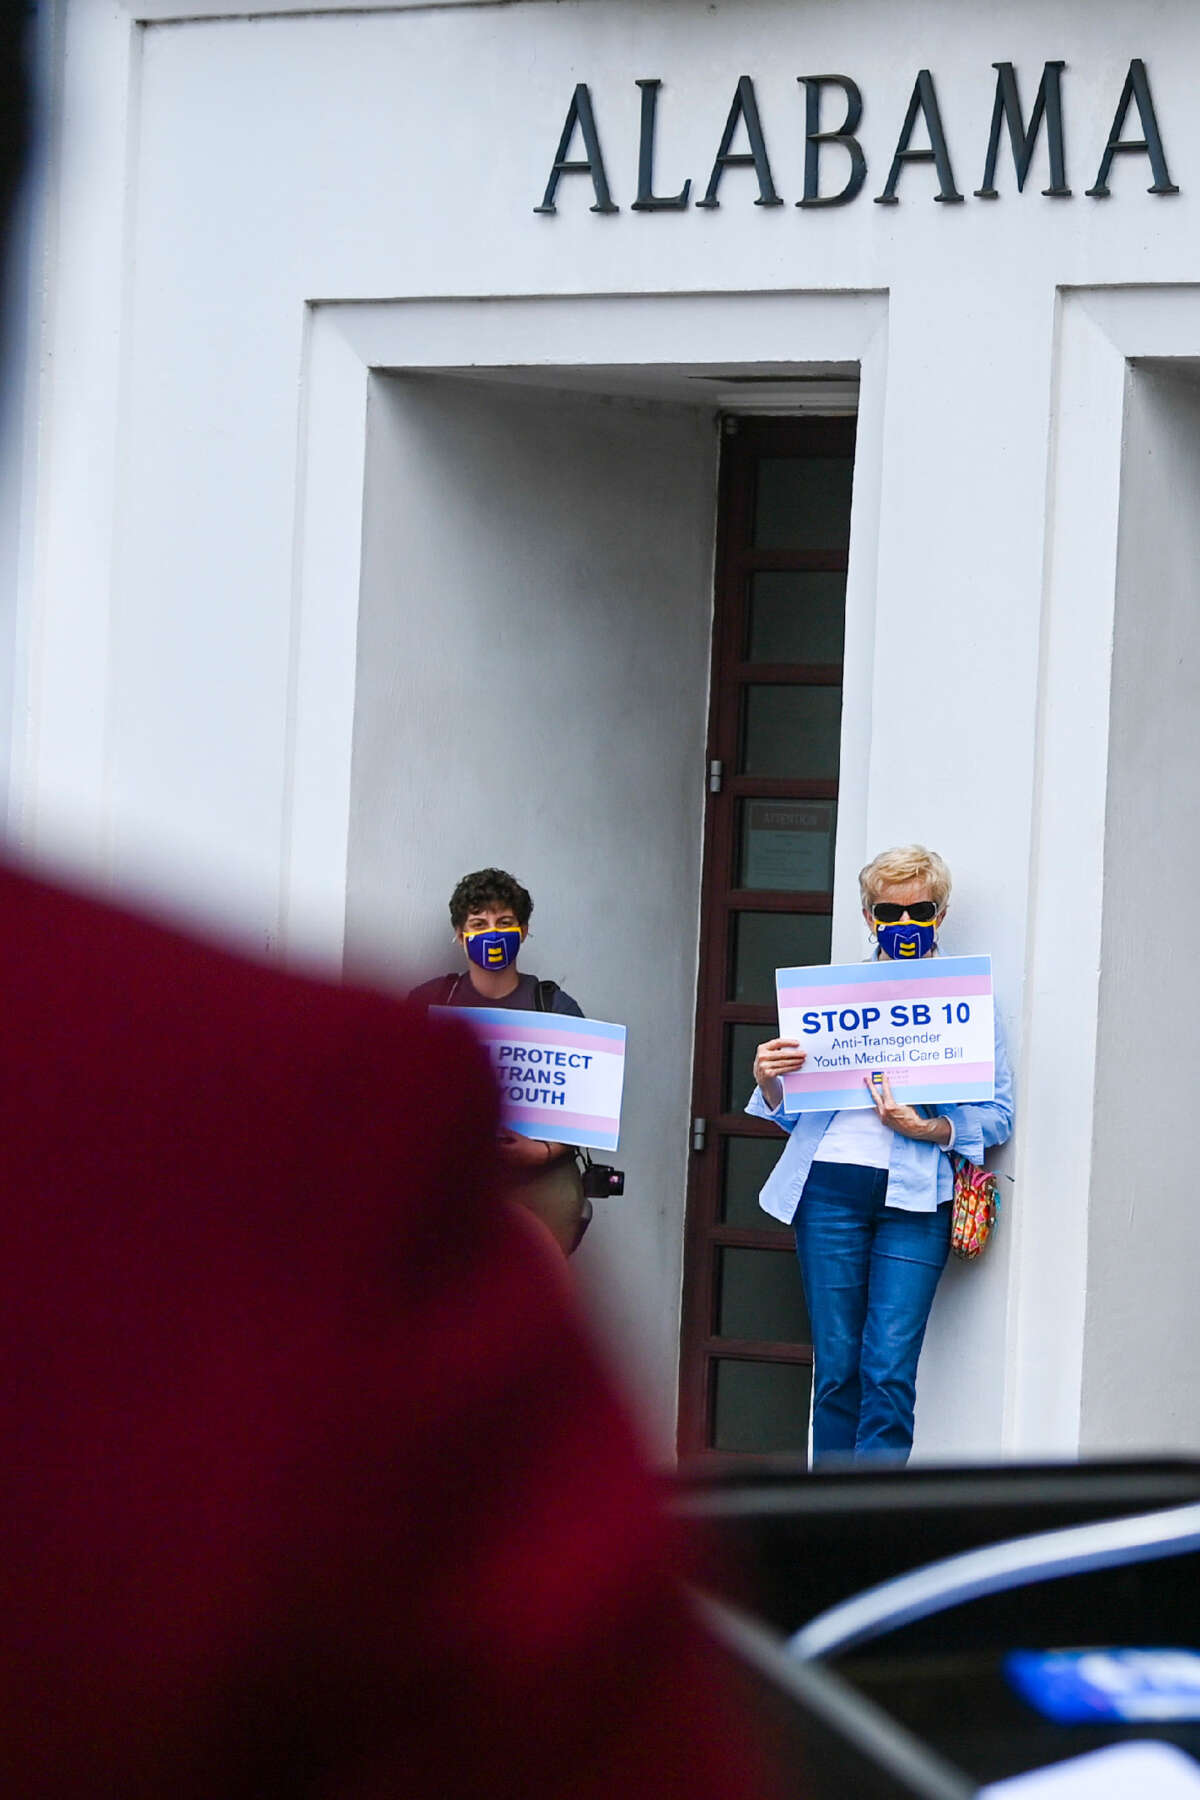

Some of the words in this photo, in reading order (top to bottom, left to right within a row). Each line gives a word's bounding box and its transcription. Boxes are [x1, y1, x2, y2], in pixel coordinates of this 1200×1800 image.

[533, 58, 1180, 213] ALABAMA
[802, 1007, 880, 1034] STOP
[890, 1004, 931, 1027] SB
[942, 1002, 970, 1024] 10
[831, 1032, 942, 1050] Anti-Transgender
[499, 1046, 593, 1069] PROTECT
[814, 1053, 850, 1068] Youth
[854, 1049, 905, 1065] Medical
[909, 1048, 940, 1062] Care
[944, 1046, 963, 1060] Bill
[497, 1066, 566, 1085] TRANS
